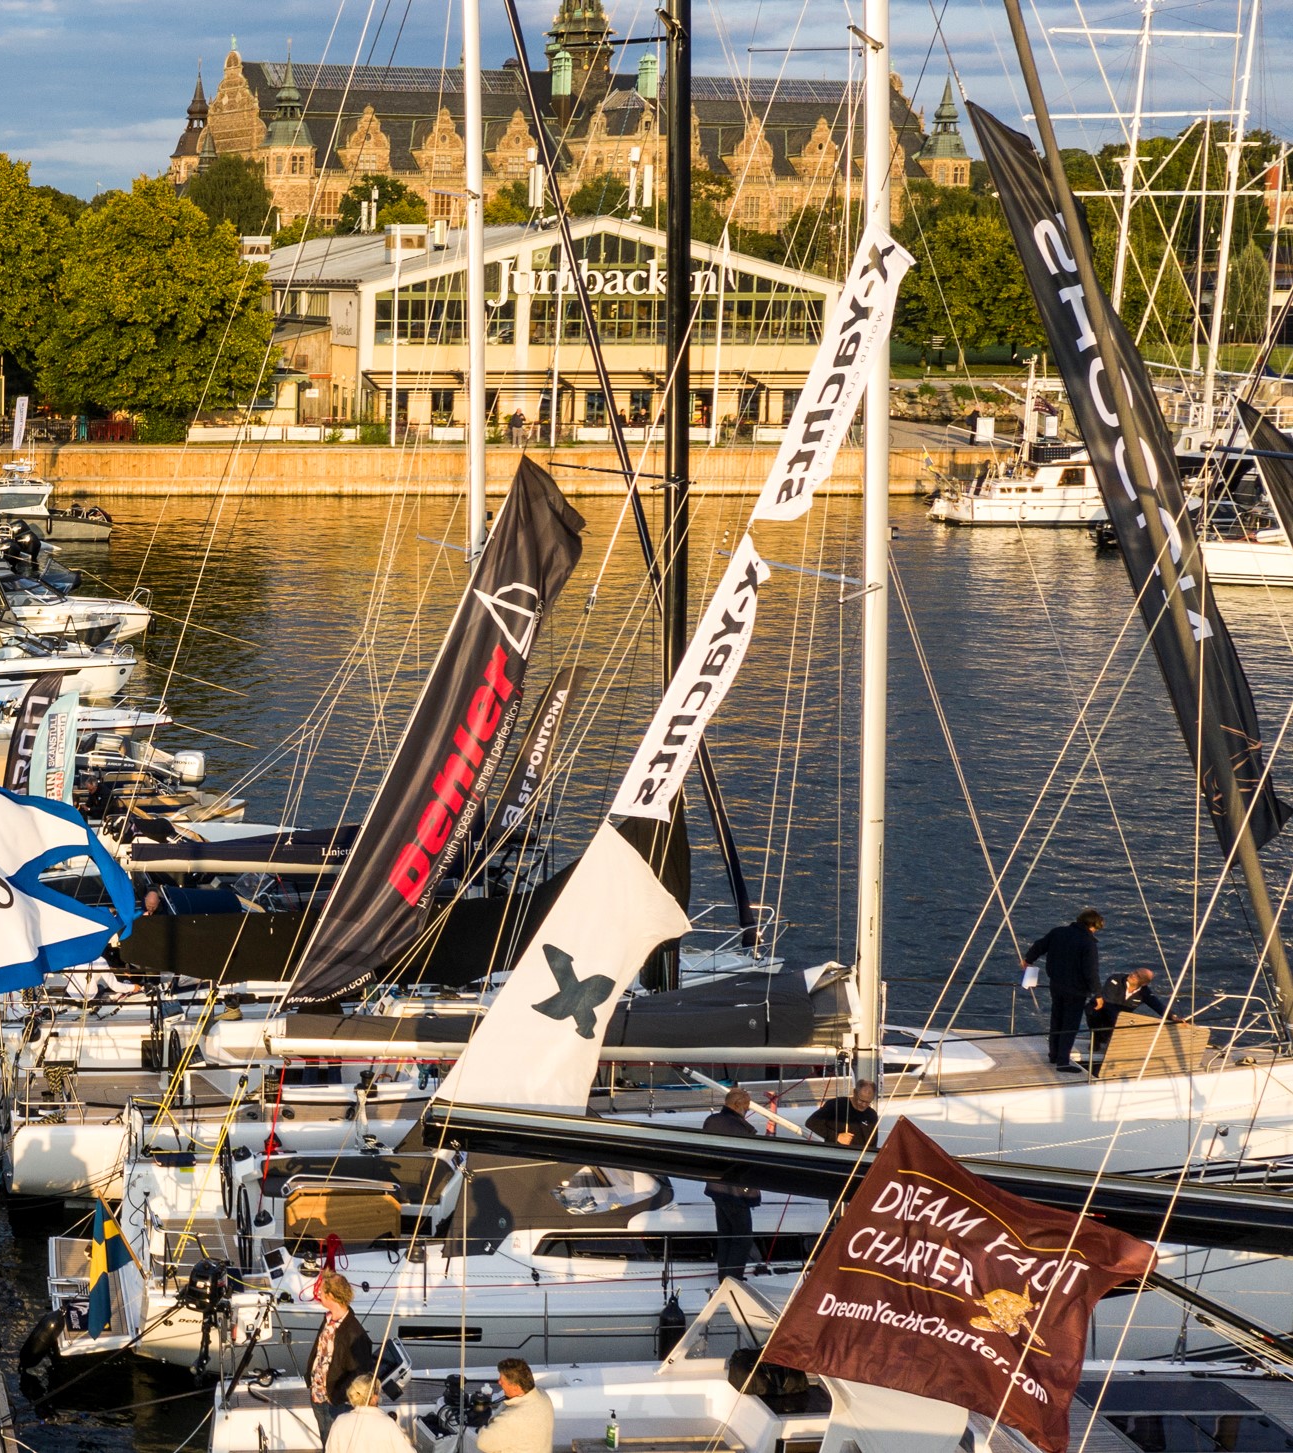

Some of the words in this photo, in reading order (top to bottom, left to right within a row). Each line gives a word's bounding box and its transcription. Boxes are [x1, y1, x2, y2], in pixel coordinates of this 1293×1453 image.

[486, 258, 721, 307] Junibackn
[48, 715, 58, 767] SKANSTULL
[388, 643, 514, 907] Dehler
[443, 840, 461, 864] with
[454, 800, 478, 839] speed
[475, 756, 497, 792] smart
[491, 699, 520, 759] perfection
[518, 780, 533, 804] SF
[526, 688, 570, 779] PONTONA
[871, 1180, 987, 1238] DREAM
[847, 1226, 974, 1296] CHARTER
[816, 1292, 1048, 1405] DreamYachtCharter.com
